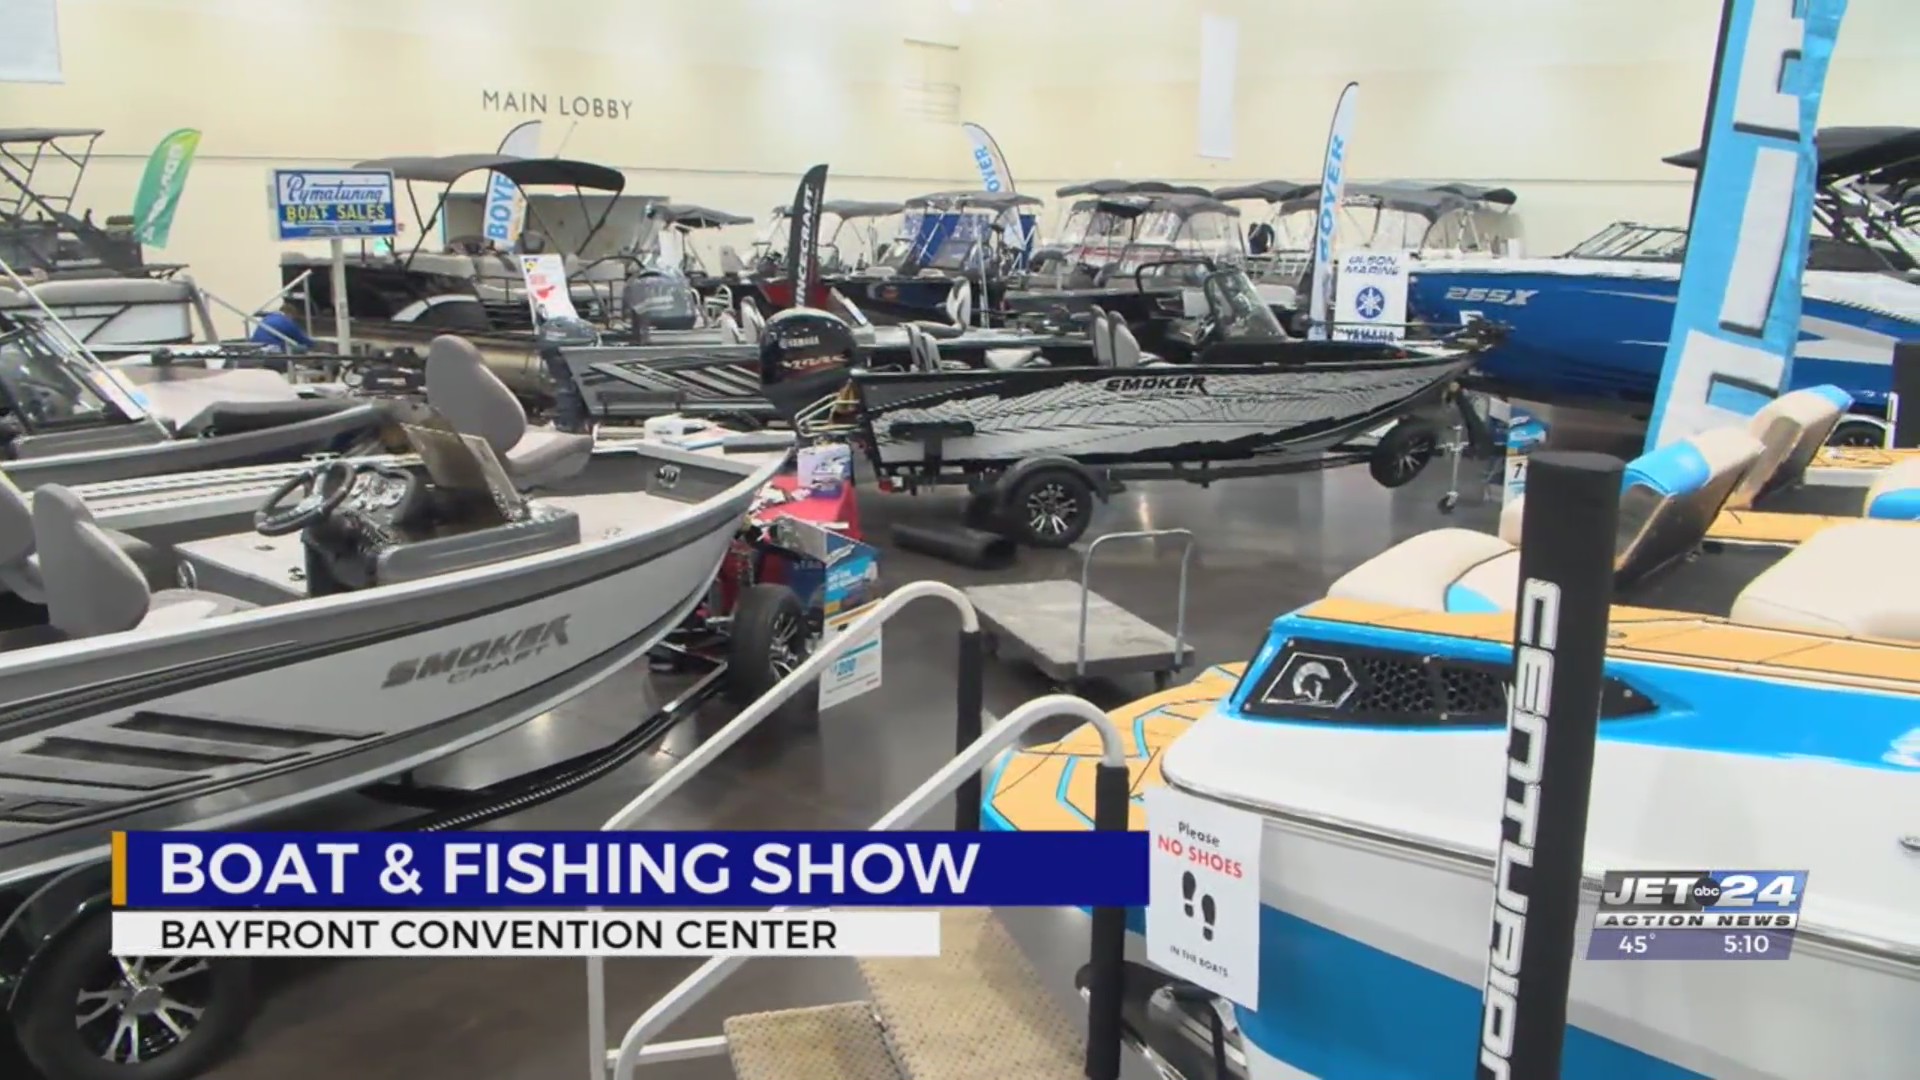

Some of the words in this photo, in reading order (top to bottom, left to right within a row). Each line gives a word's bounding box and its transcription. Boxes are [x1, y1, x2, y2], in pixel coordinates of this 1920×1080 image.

[483, 90, 547, 114] MAIN
[559, 95, 632, 120] LOBBY
[975, 145, 1000, 192] OYER
[287, 173, 383, 205] Pymatuning
[286, 203, 330, 221] BOAT
[336, 203, 386, 220] SALES
[487, 174, 516, 240] BOYE
[796, 184, 814, 306] INCECRAFT
[1104, 376, 1209, 396] SMOKER
[381, 613, 572, 690] SMOKER
[1178, 821, 1220, 847] Please
[1158, 834, 1183, 856] NO
[1188, 846, 1243, 879] SHOES
[1182, 949, 1197, 964] THE
[1199, 957, 1229, 978] BOATS
